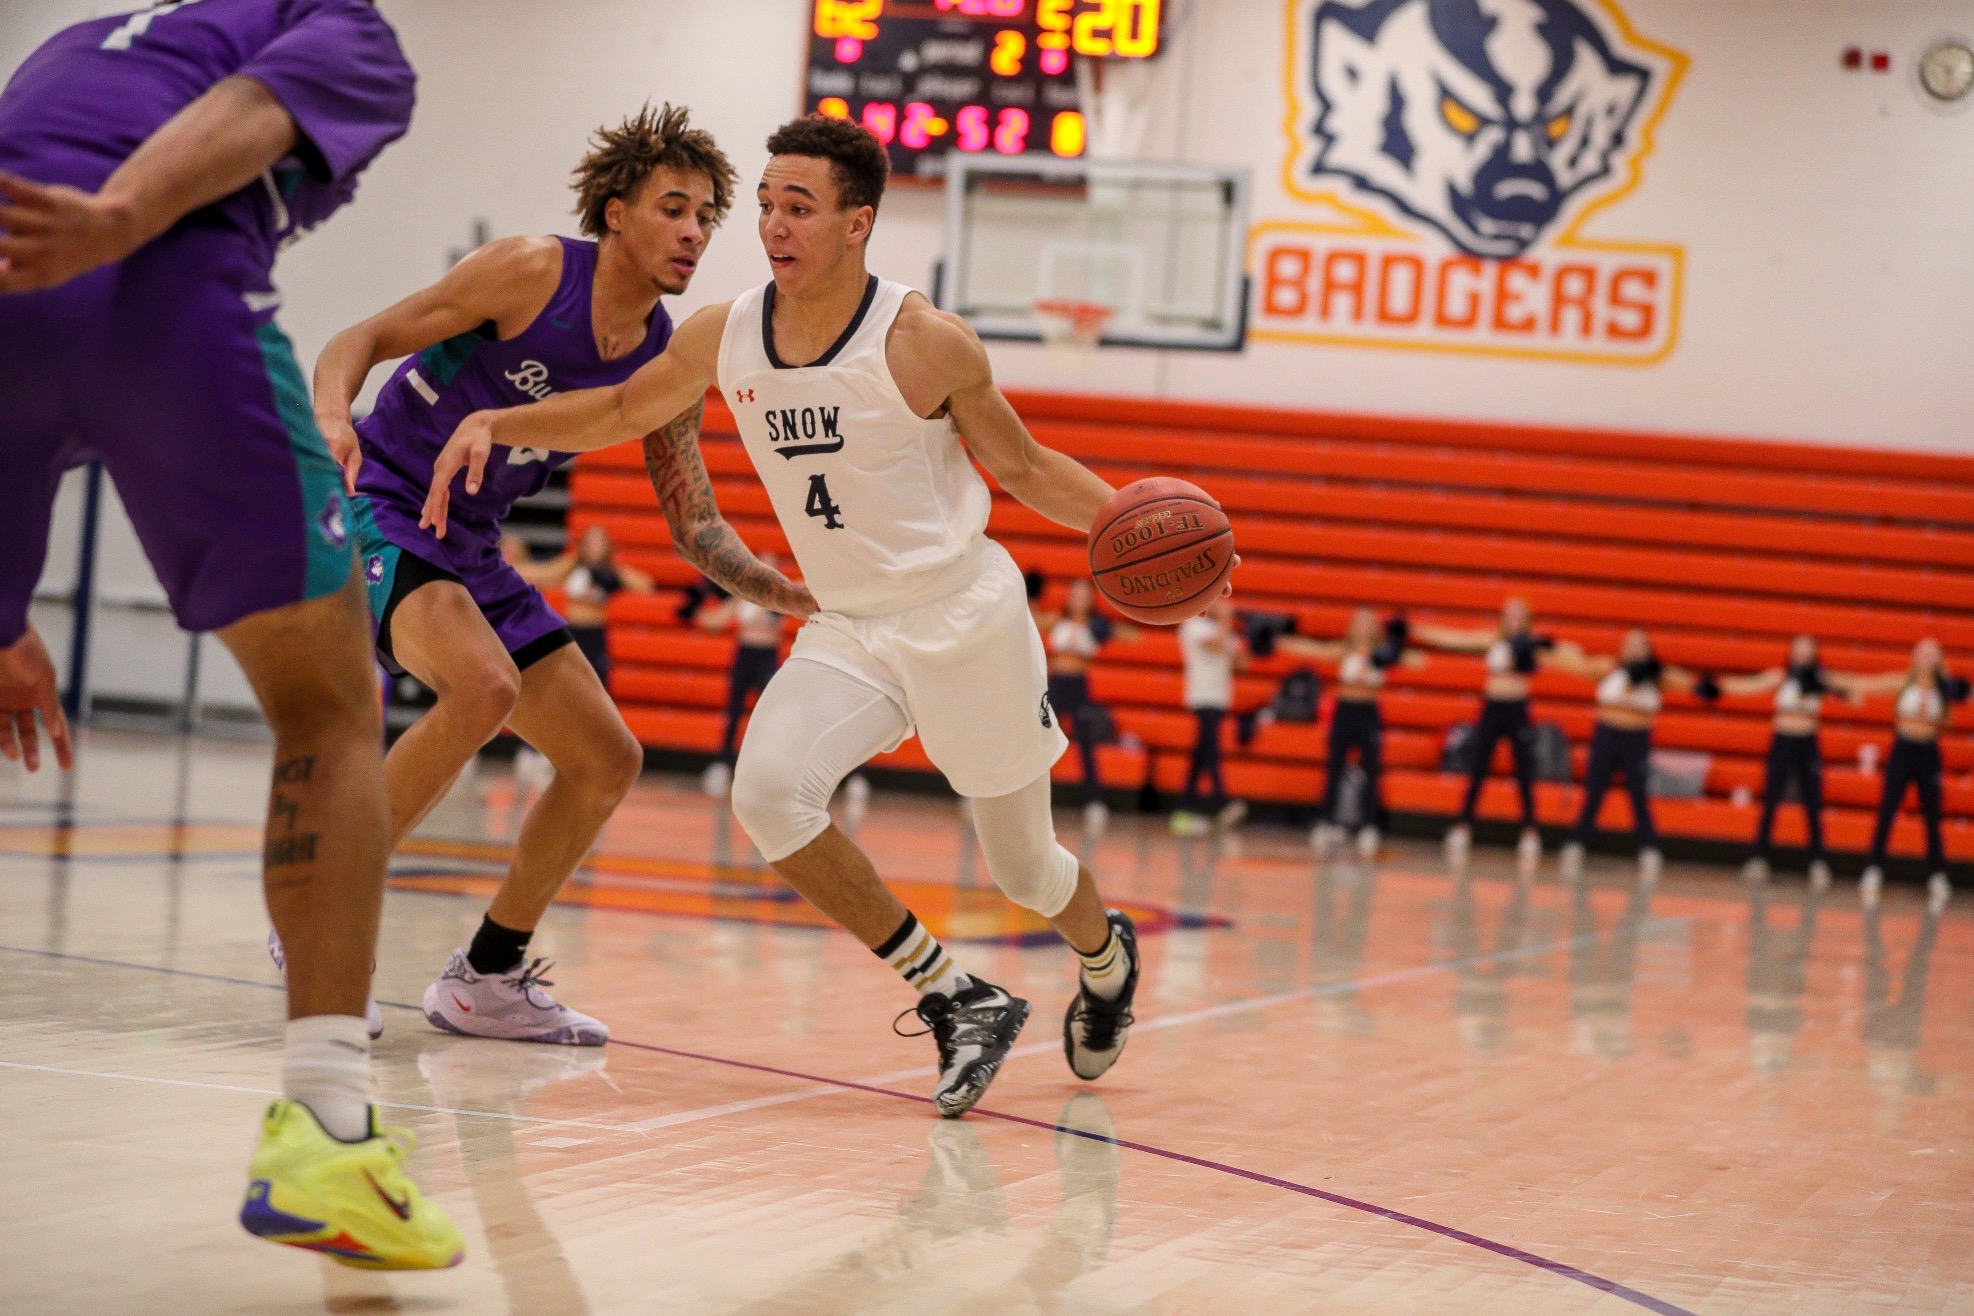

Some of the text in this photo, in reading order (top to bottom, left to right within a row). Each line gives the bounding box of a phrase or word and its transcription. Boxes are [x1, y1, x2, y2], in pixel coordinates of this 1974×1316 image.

[1263, 245, 1659, 341] BADGERS
[765, 406, 840, 441] SNOW
[805, 474, 844, 529] 4
[1112, 513, 1205, 555] TF-1000
[1119, 547, 1217, 597] SPALDING
